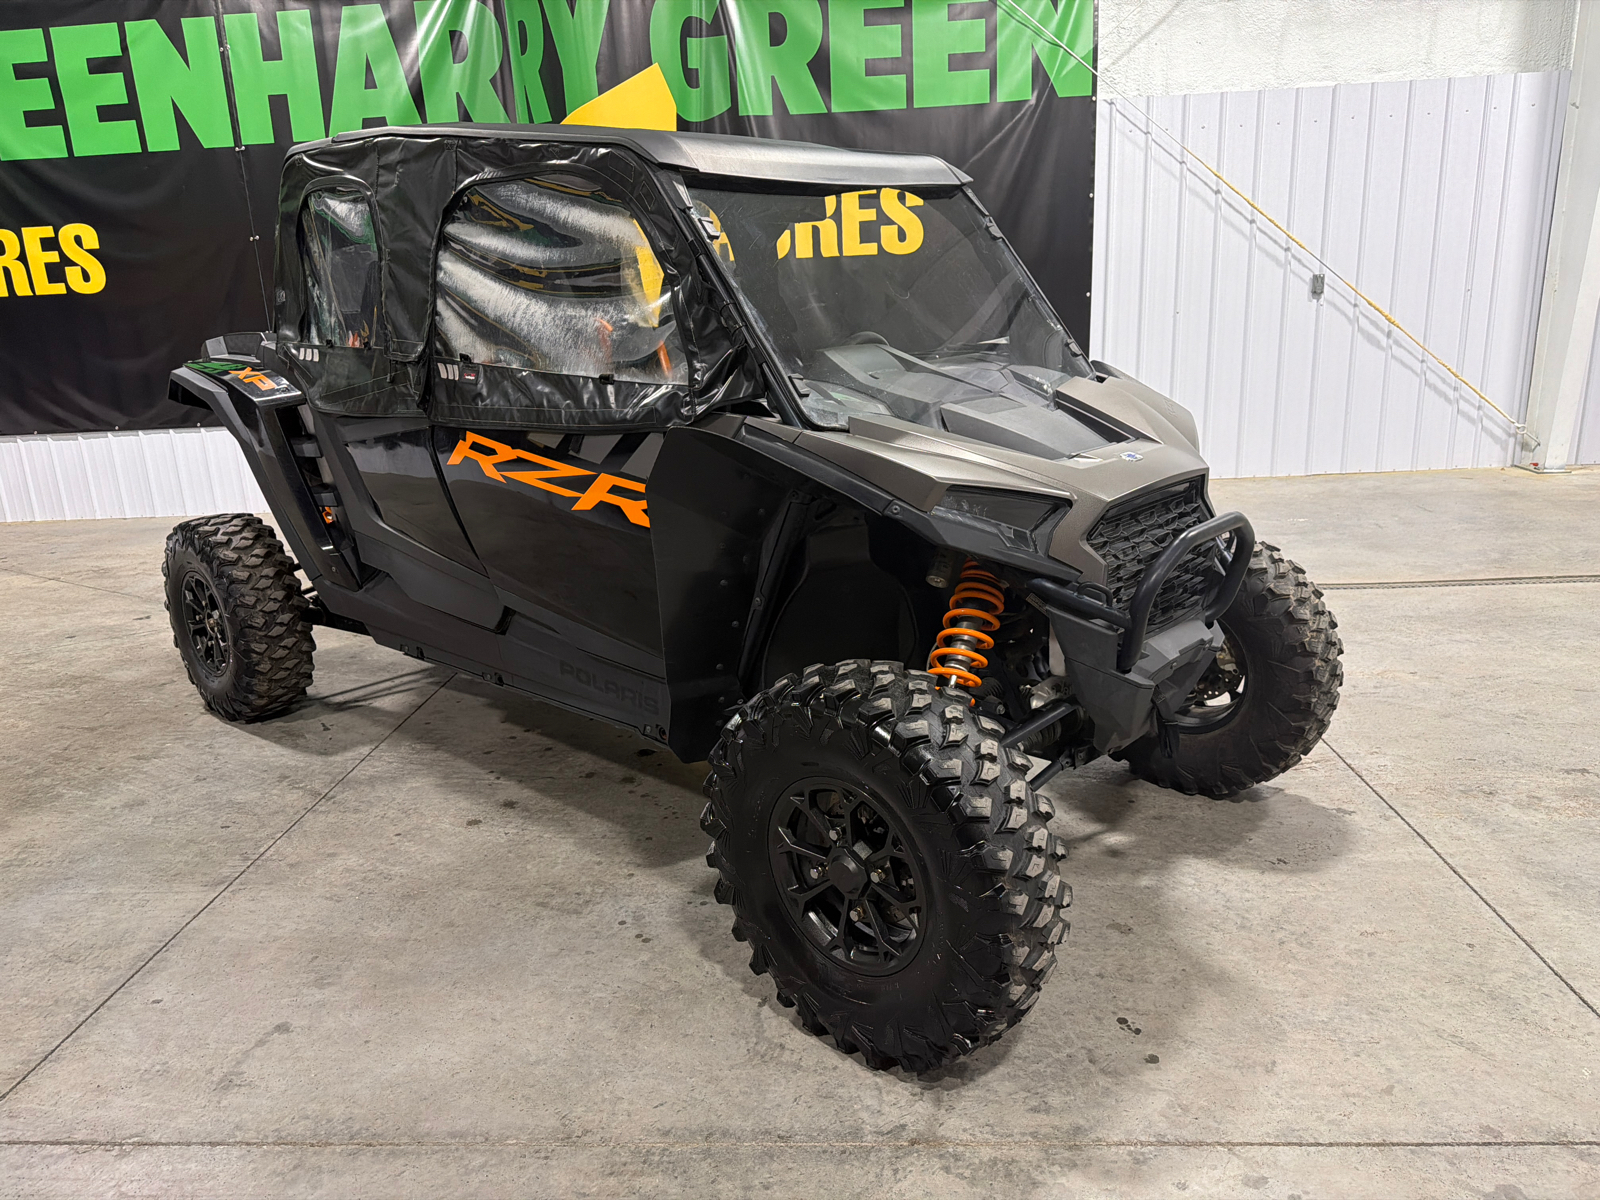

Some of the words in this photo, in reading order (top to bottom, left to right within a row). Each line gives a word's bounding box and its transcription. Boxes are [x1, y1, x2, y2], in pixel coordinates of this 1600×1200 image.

[223, 0, 609, 146] HARRY
[649, 0, 1093, 122] GREEN
[228, 366, 279, 391] XP
[446, 430, 652, 529] RZR
[559, 659, 660, 717] POLARIS
